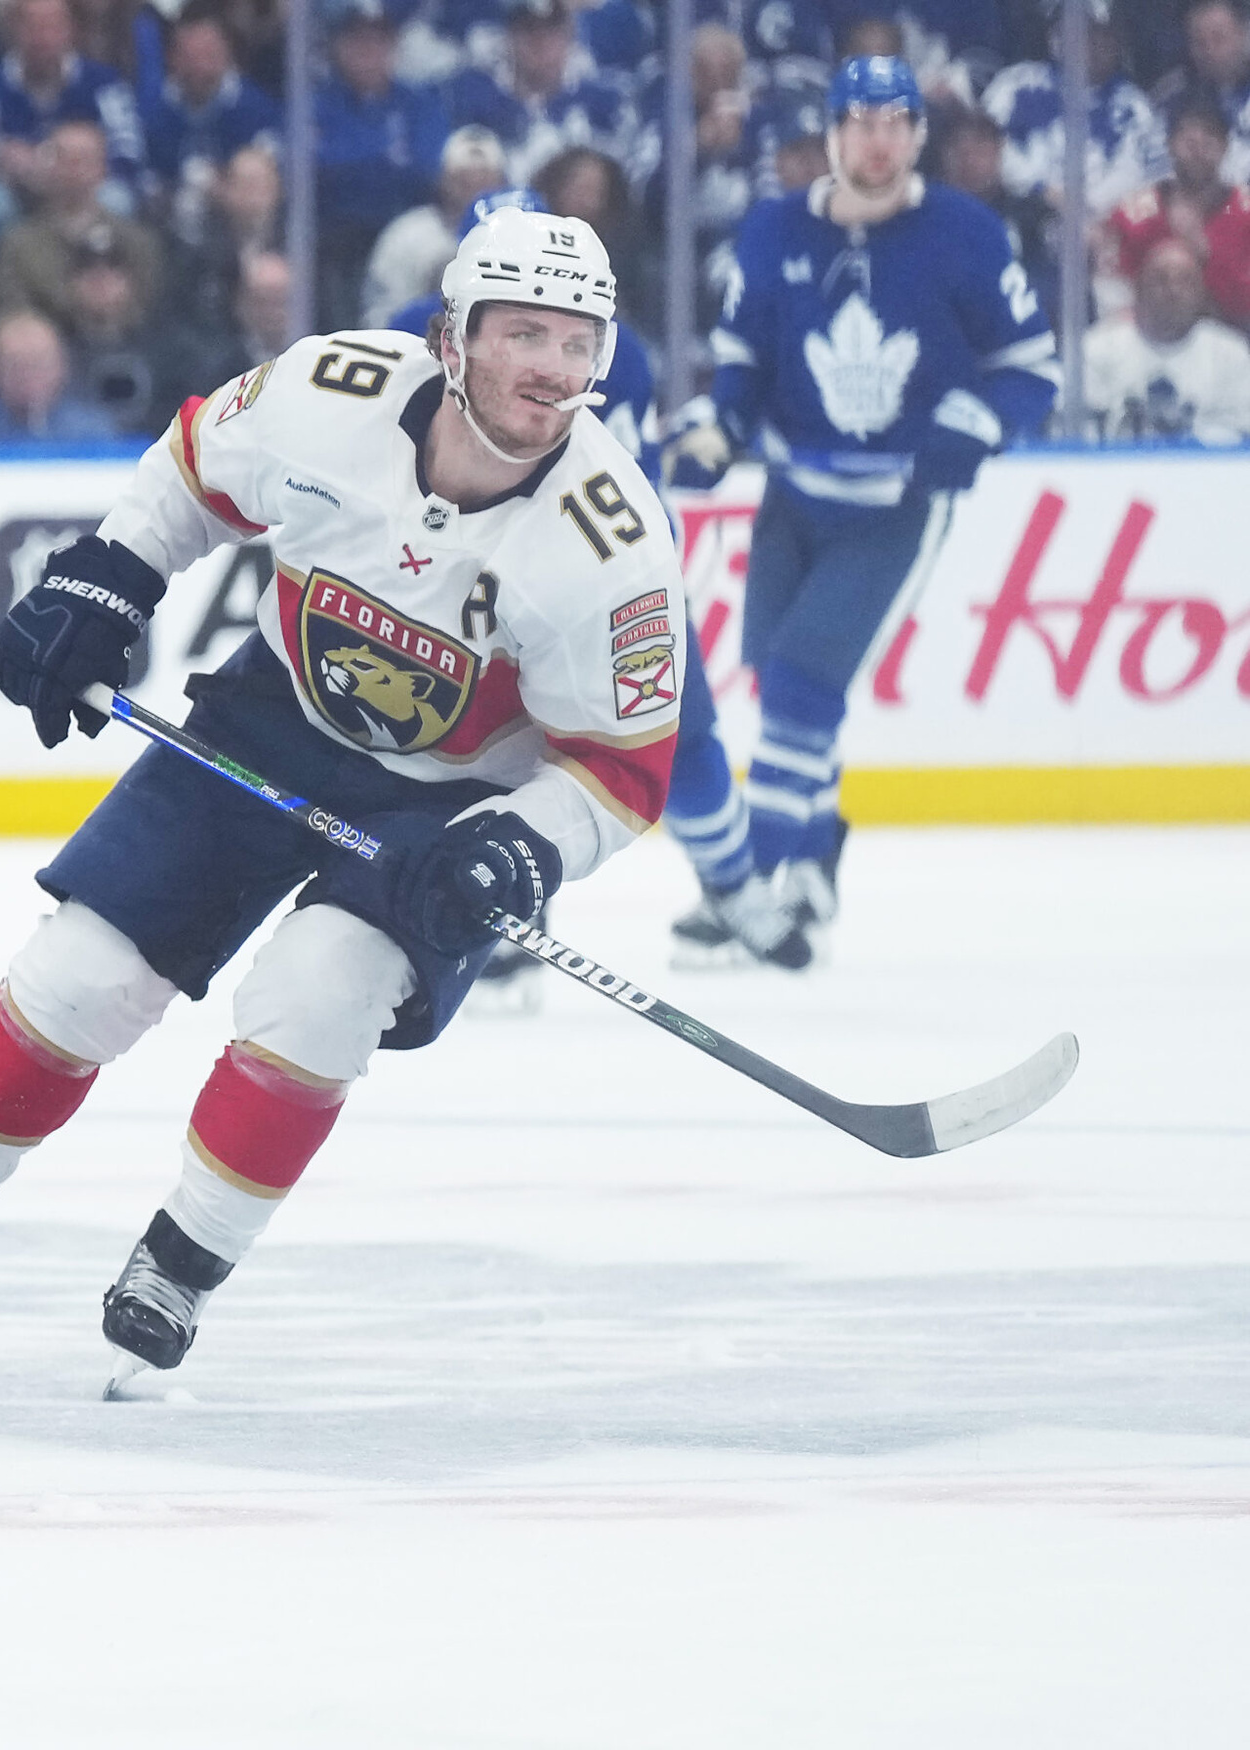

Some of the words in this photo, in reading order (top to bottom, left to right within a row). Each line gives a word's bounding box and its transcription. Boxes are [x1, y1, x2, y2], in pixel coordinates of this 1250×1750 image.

[549, 230, 575, 247] 19
[534, 265, 588, 282] CCM
[309, 338, 404, 400] 19
[285, 477, 341, 509] AutoNation
[559, 470, 647, 564] 19
[319, 588, 457, 674] FLORIDA
[461, 570, 501, 641] A
[621, 620, 665, 645] PANTHERS
[307, 807, 382, 861] CODE
[500, 913, 657, 1012] RWOOD
